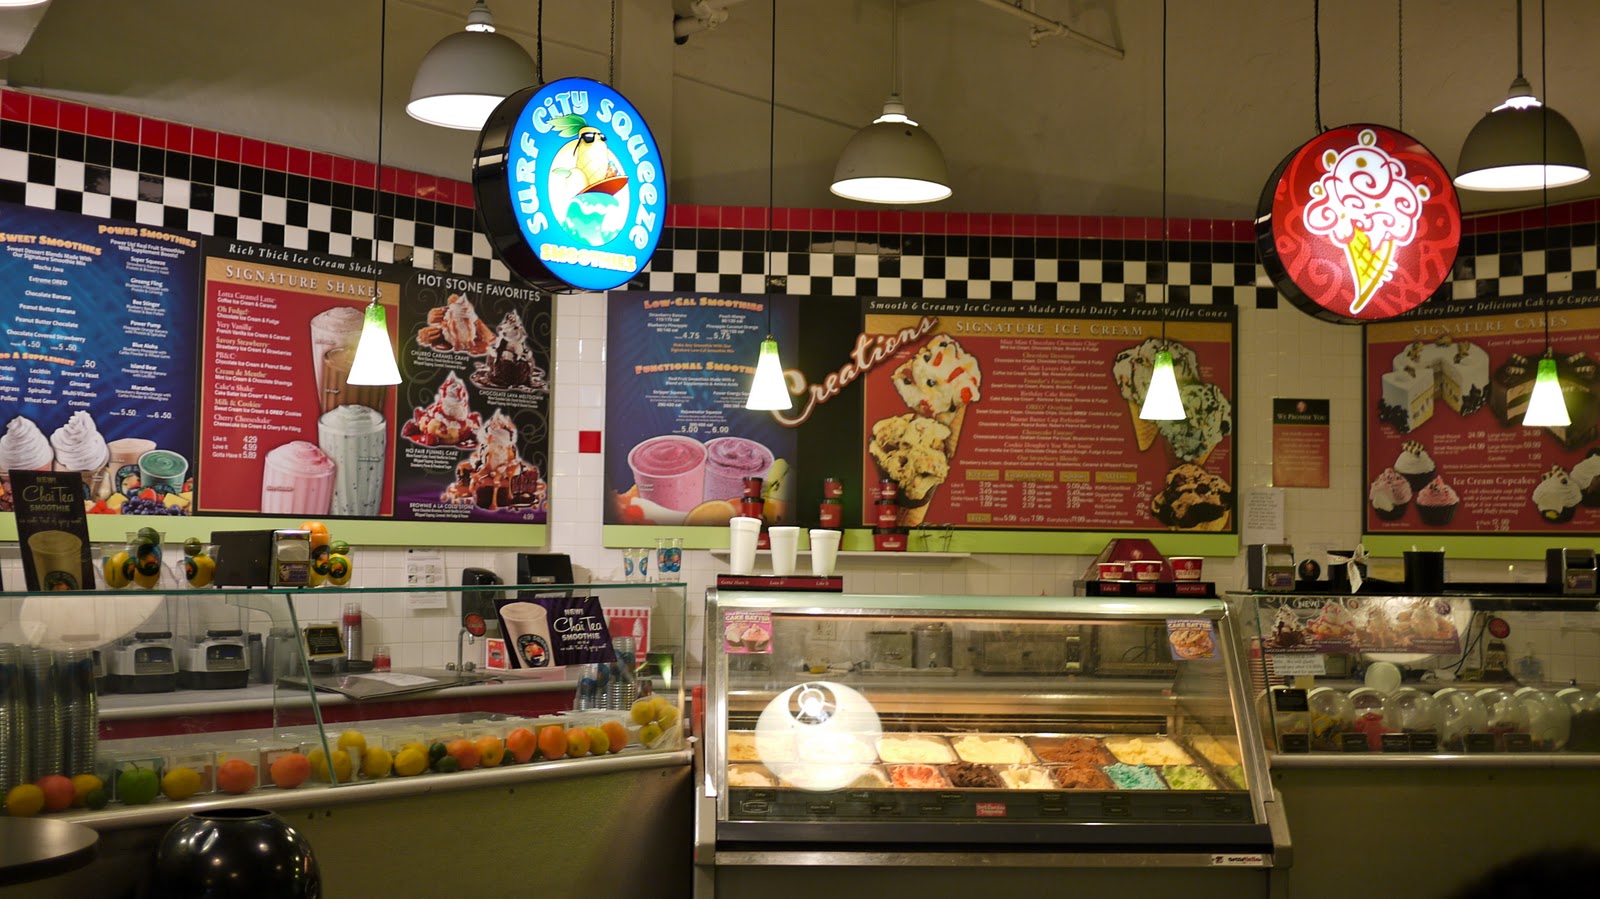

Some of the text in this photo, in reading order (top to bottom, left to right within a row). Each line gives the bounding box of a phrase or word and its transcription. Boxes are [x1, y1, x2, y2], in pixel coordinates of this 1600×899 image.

[98, 225, 197, 248] POWER SMOOTHIES
[38, 235, 102, 256] SMOOTHIES
[229, 244, 382, 275] Rich Thick Ice Cream Shakes
[226, 265, 383, 297] SIGNATURE SHAKES
[418, 274, 540, 302] HOT STONE FAVORITES
[700, 297, 764, 312] SMOOTHIES
[870, 301, 908, 310] Smooth
[922, 302, 962, 313] Creamy
[964, 303, 981, 312] Ice
[983, 304, 1016, 313] Cream
[1028, 304, 1055, 314] Made
[1058, 306, 1087, 315] Fresh
[1089, 306, 1119, 317] Daily
[1131, 307, 1158, 316] Fresh
[1417, 307, 1444, 315] Every
[1567, 294, 1600, 304] Cupca
[956, 322, 1143, 336] SIGNATURE ICE CREAM
[1414, 322, 1504, 335] SIGNATURE
[706, 361, 757, 374] SMOOTHI
[1453, 476, 1465, 485] Ice
[1467, 477, 1494, 485] Cream
[553, 616, 602, 633] Chai Tea
[562, 632, 600, 641] SMOOTHIE
